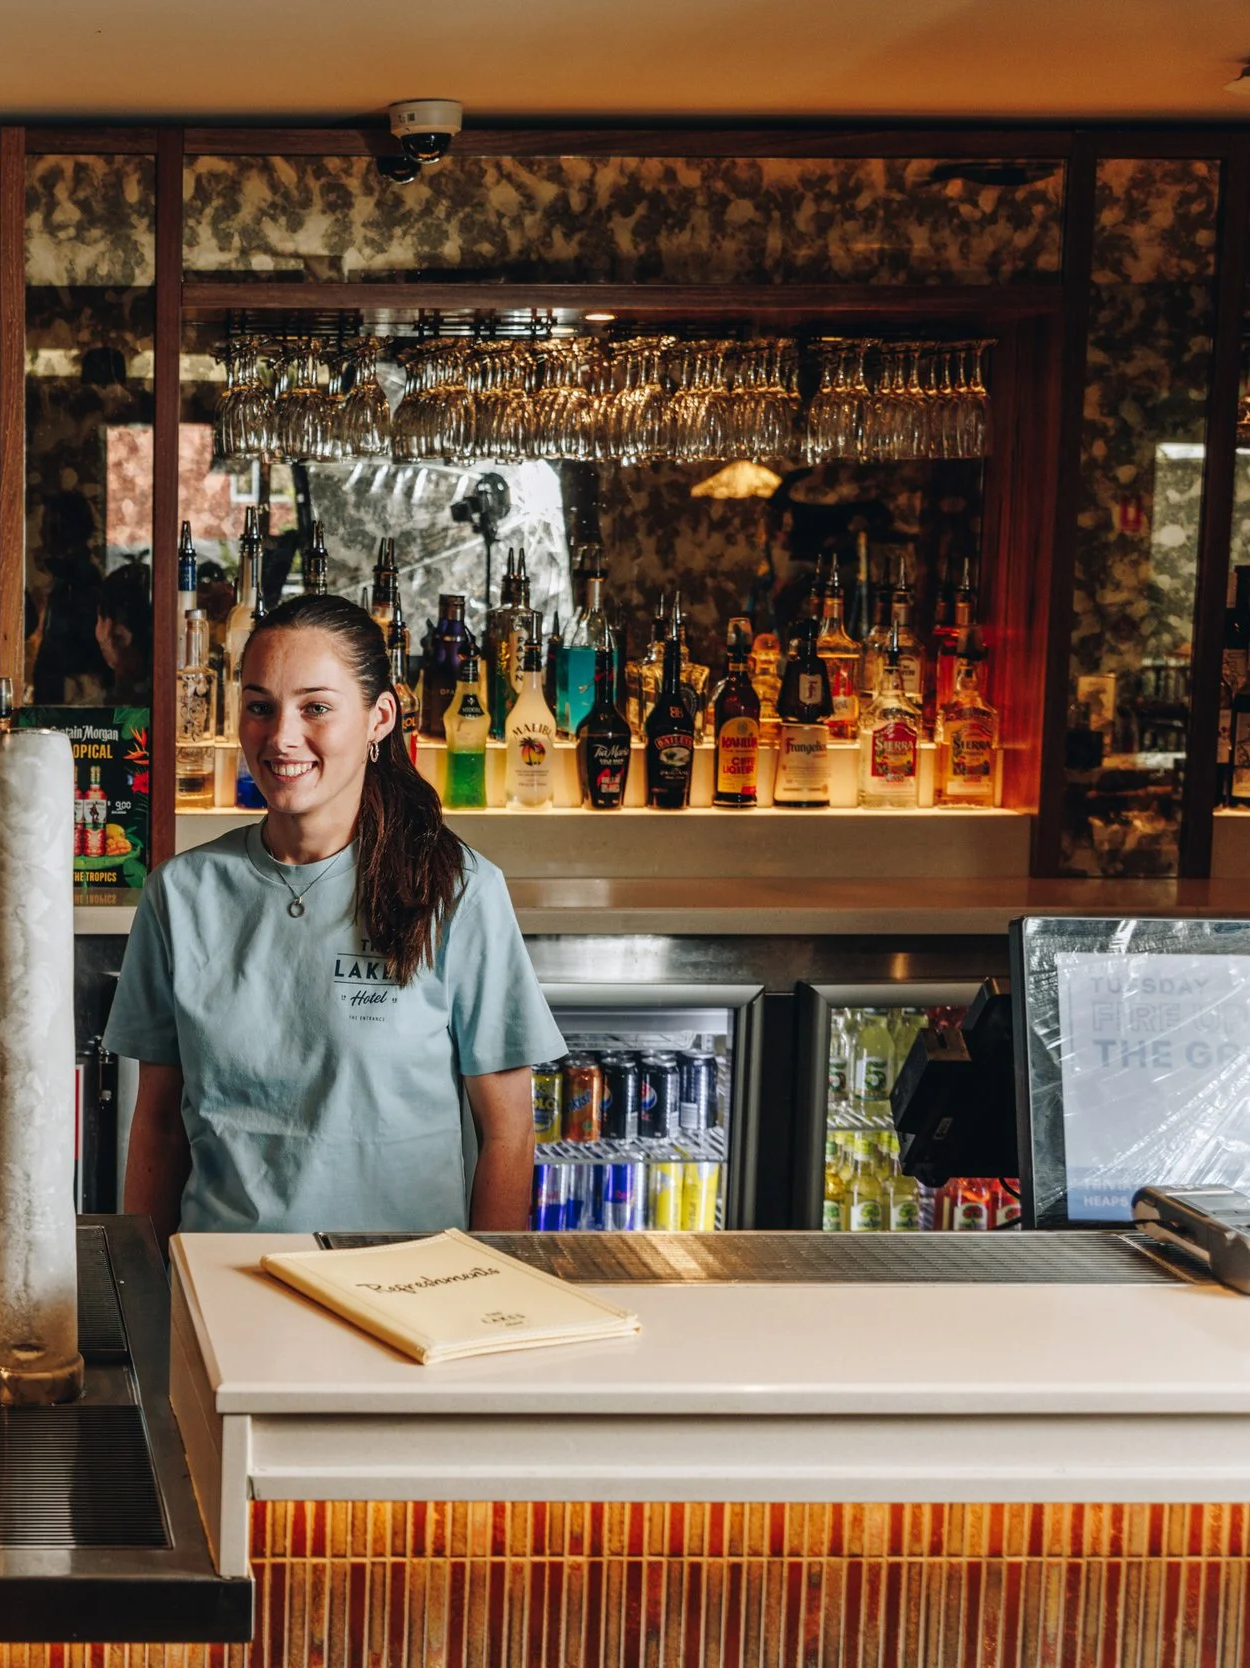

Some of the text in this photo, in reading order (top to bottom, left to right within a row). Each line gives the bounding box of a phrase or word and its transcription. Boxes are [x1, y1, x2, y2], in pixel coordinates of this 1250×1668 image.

[82, 725, 119, 741] Morgan
[73, 744, 113, 759] OPICAL
[86, 872, 117, 882] TROPICS
[334, 959, 392, 980] LAKE
[1091, 977, 1210, 995] TUESDAY
[350, 990, 388, 1006] Hotel
[1092, 1039, 1173, 1069] THE
[355, 1266, 501, 1296] Refreshments
